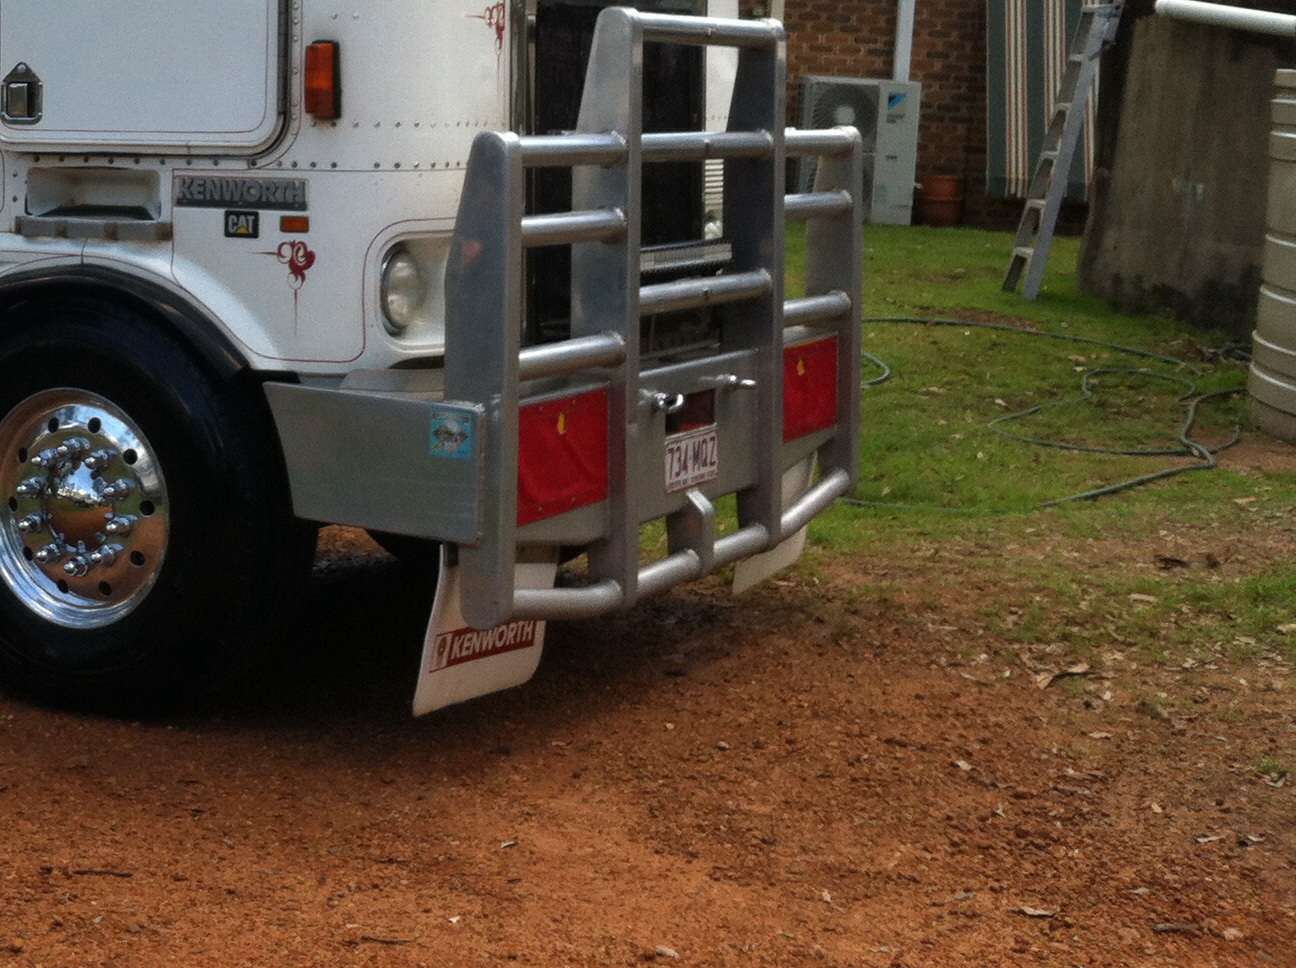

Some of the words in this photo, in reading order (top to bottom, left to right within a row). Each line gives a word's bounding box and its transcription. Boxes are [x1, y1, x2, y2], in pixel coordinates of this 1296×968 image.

[178, 177, 306, 204] KENWORTH
[227, 214, 255, 233] CAT
[450, 620, 536, 660] KENWORTH
